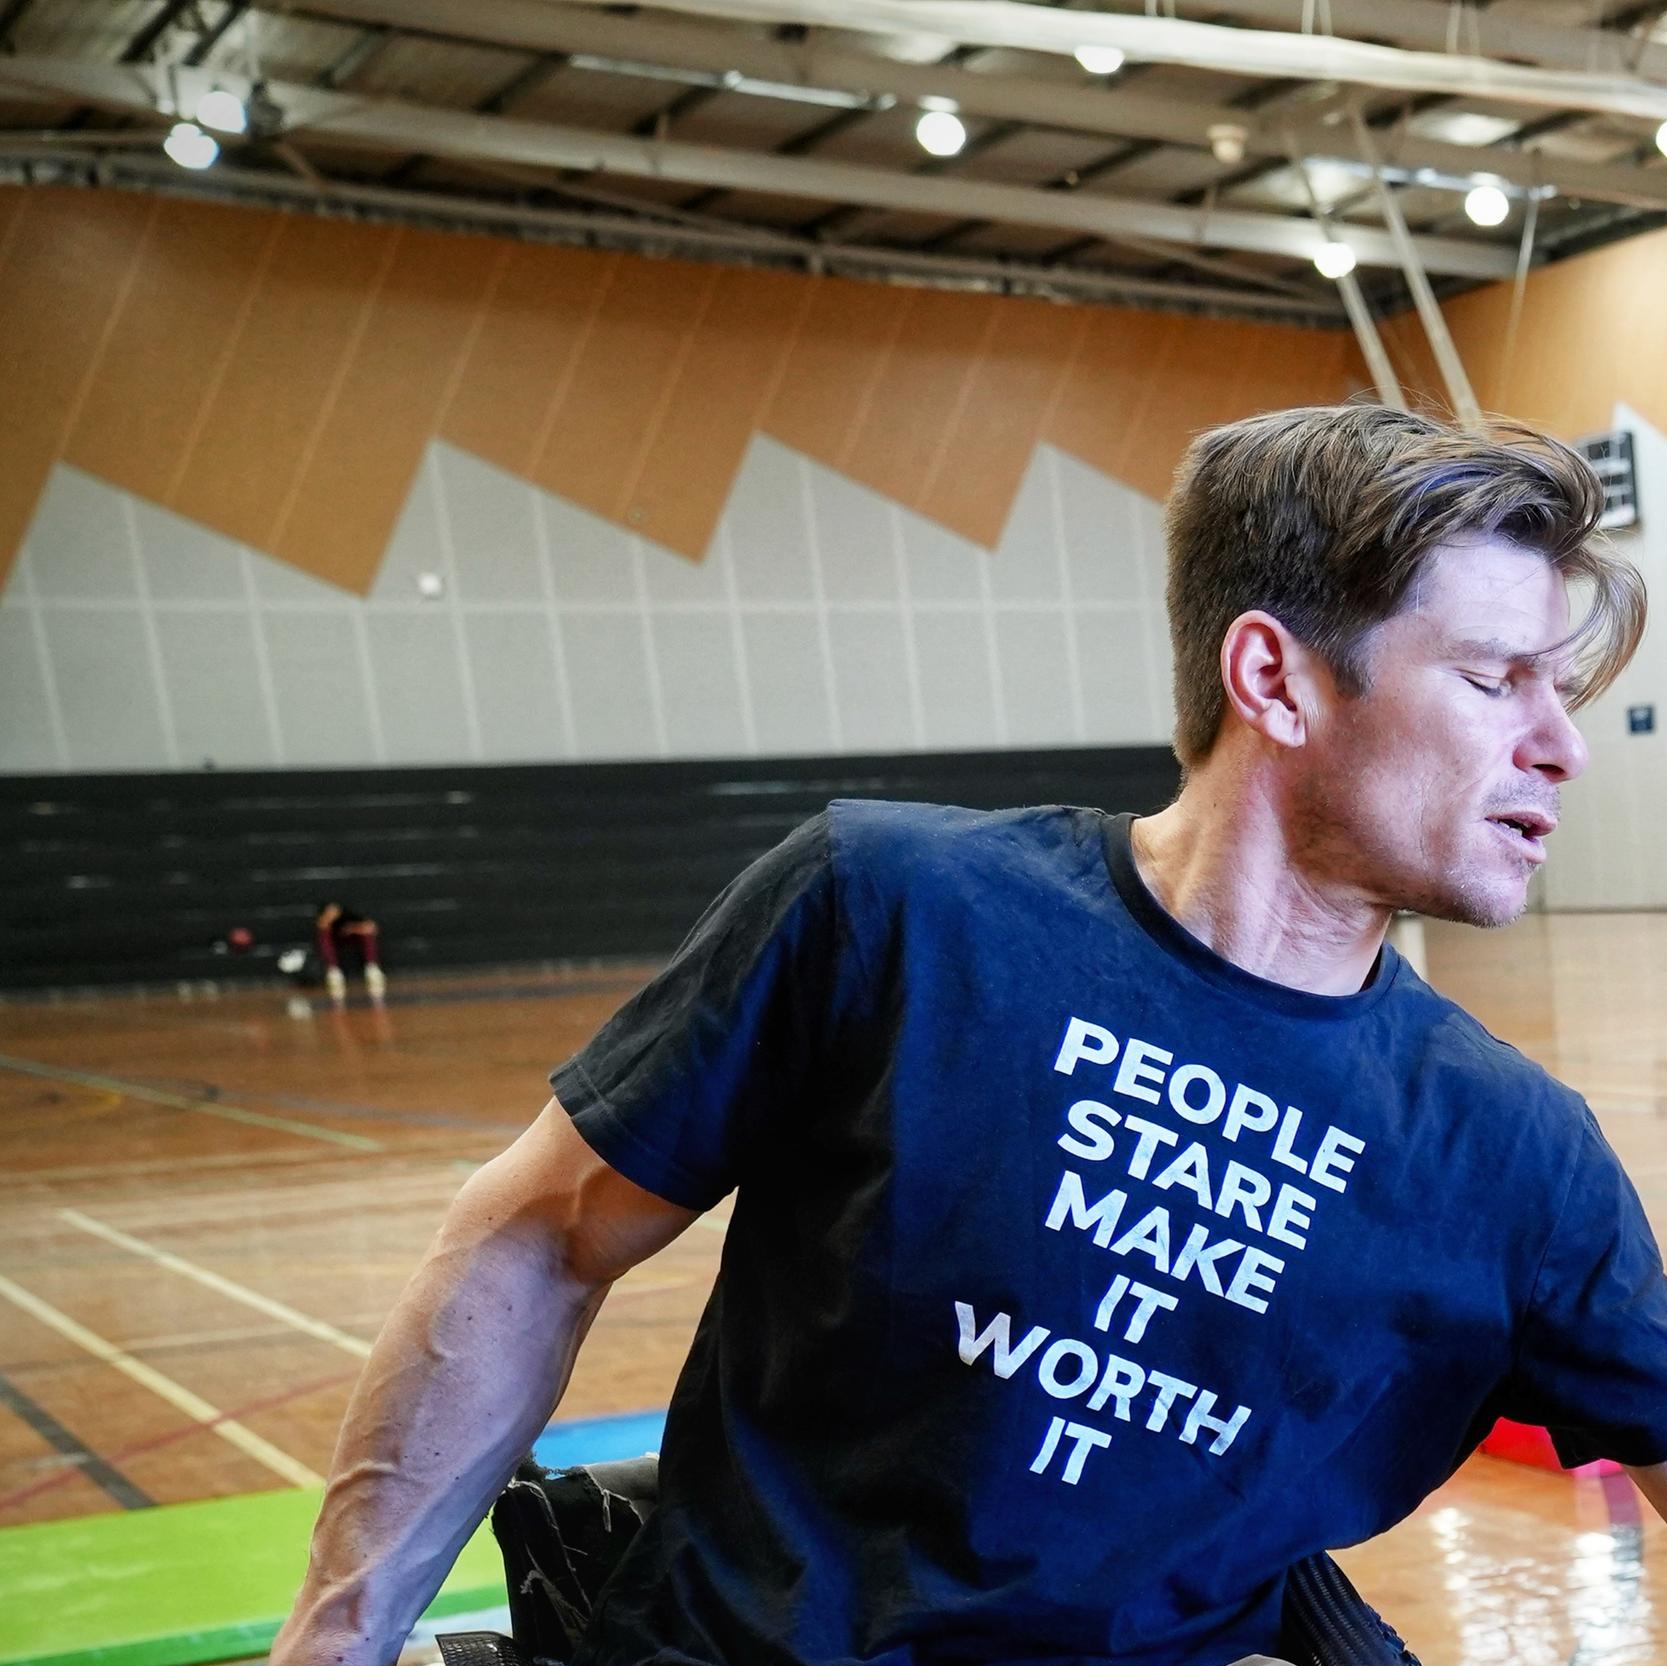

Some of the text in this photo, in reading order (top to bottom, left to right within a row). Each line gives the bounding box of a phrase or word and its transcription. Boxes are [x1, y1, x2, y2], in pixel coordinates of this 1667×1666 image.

[1054, 1017, 1365, 1193] PEOPLE
[1058, 1100, 1316, 1250] STARE
[1045, 1170, 1285, 1314] MAKE
[1094, 1274, 1179, 1343] IT
[955, 1301, 1251, 1456] WORTH
[1030, 1417, 1112, 1485] IT
